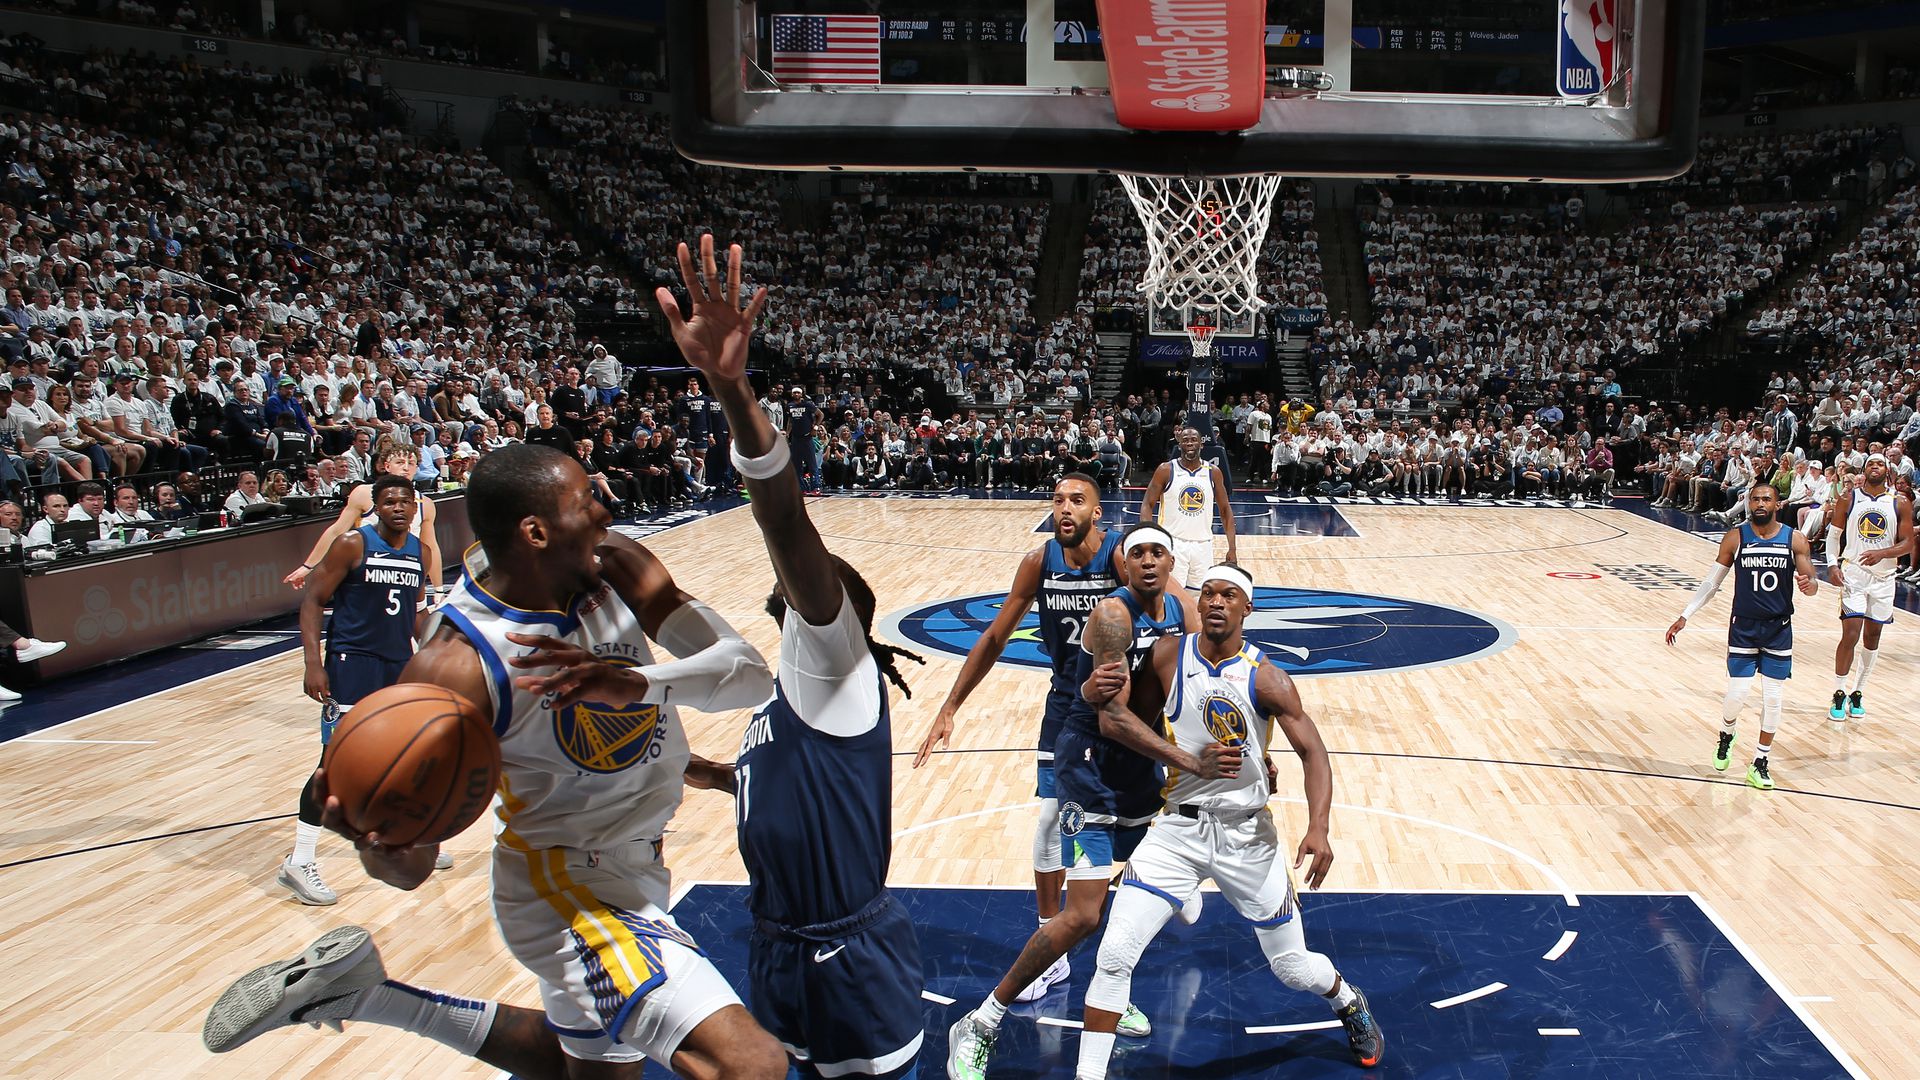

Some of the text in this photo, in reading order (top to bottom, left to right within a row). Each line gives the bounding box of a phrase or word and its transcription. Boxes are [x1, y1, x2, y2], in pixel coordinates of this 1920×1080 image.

[889, 20, 929, 30] SPORTS RADIO
[888, 30, 898, 39] FM
[1498, 31, 1519, 40] Jaden
[193, 40, 217, 51] 136
[1304, 37, 1310, 45] 4
[1142, 48, 1230, 92] State
[1566, 67, 1593, 89] NBA
[628, 92, 645, 102] 138
[1752, 115, 1768, 125] 104
[1194, 382, 1206, 393] GET
[1194, 392, 1206, 402] THE
[1197, 402, 1208, 414] App
[1193, 491, 1203, 500] 23
[1264, 495, 1615, 509] MINNESOTA
[1877, 517, 1883, 526] 7
[1741, 556, 1788, 569] MINNESOTA
[365, 568, 420, 588] MINNESOTA
[1751, 570, 1779, 592] 10
[130, 561, 280, 631] State Farm
[385, 589, 401, 616] 5
[593, 641, 640, 658] STATE
